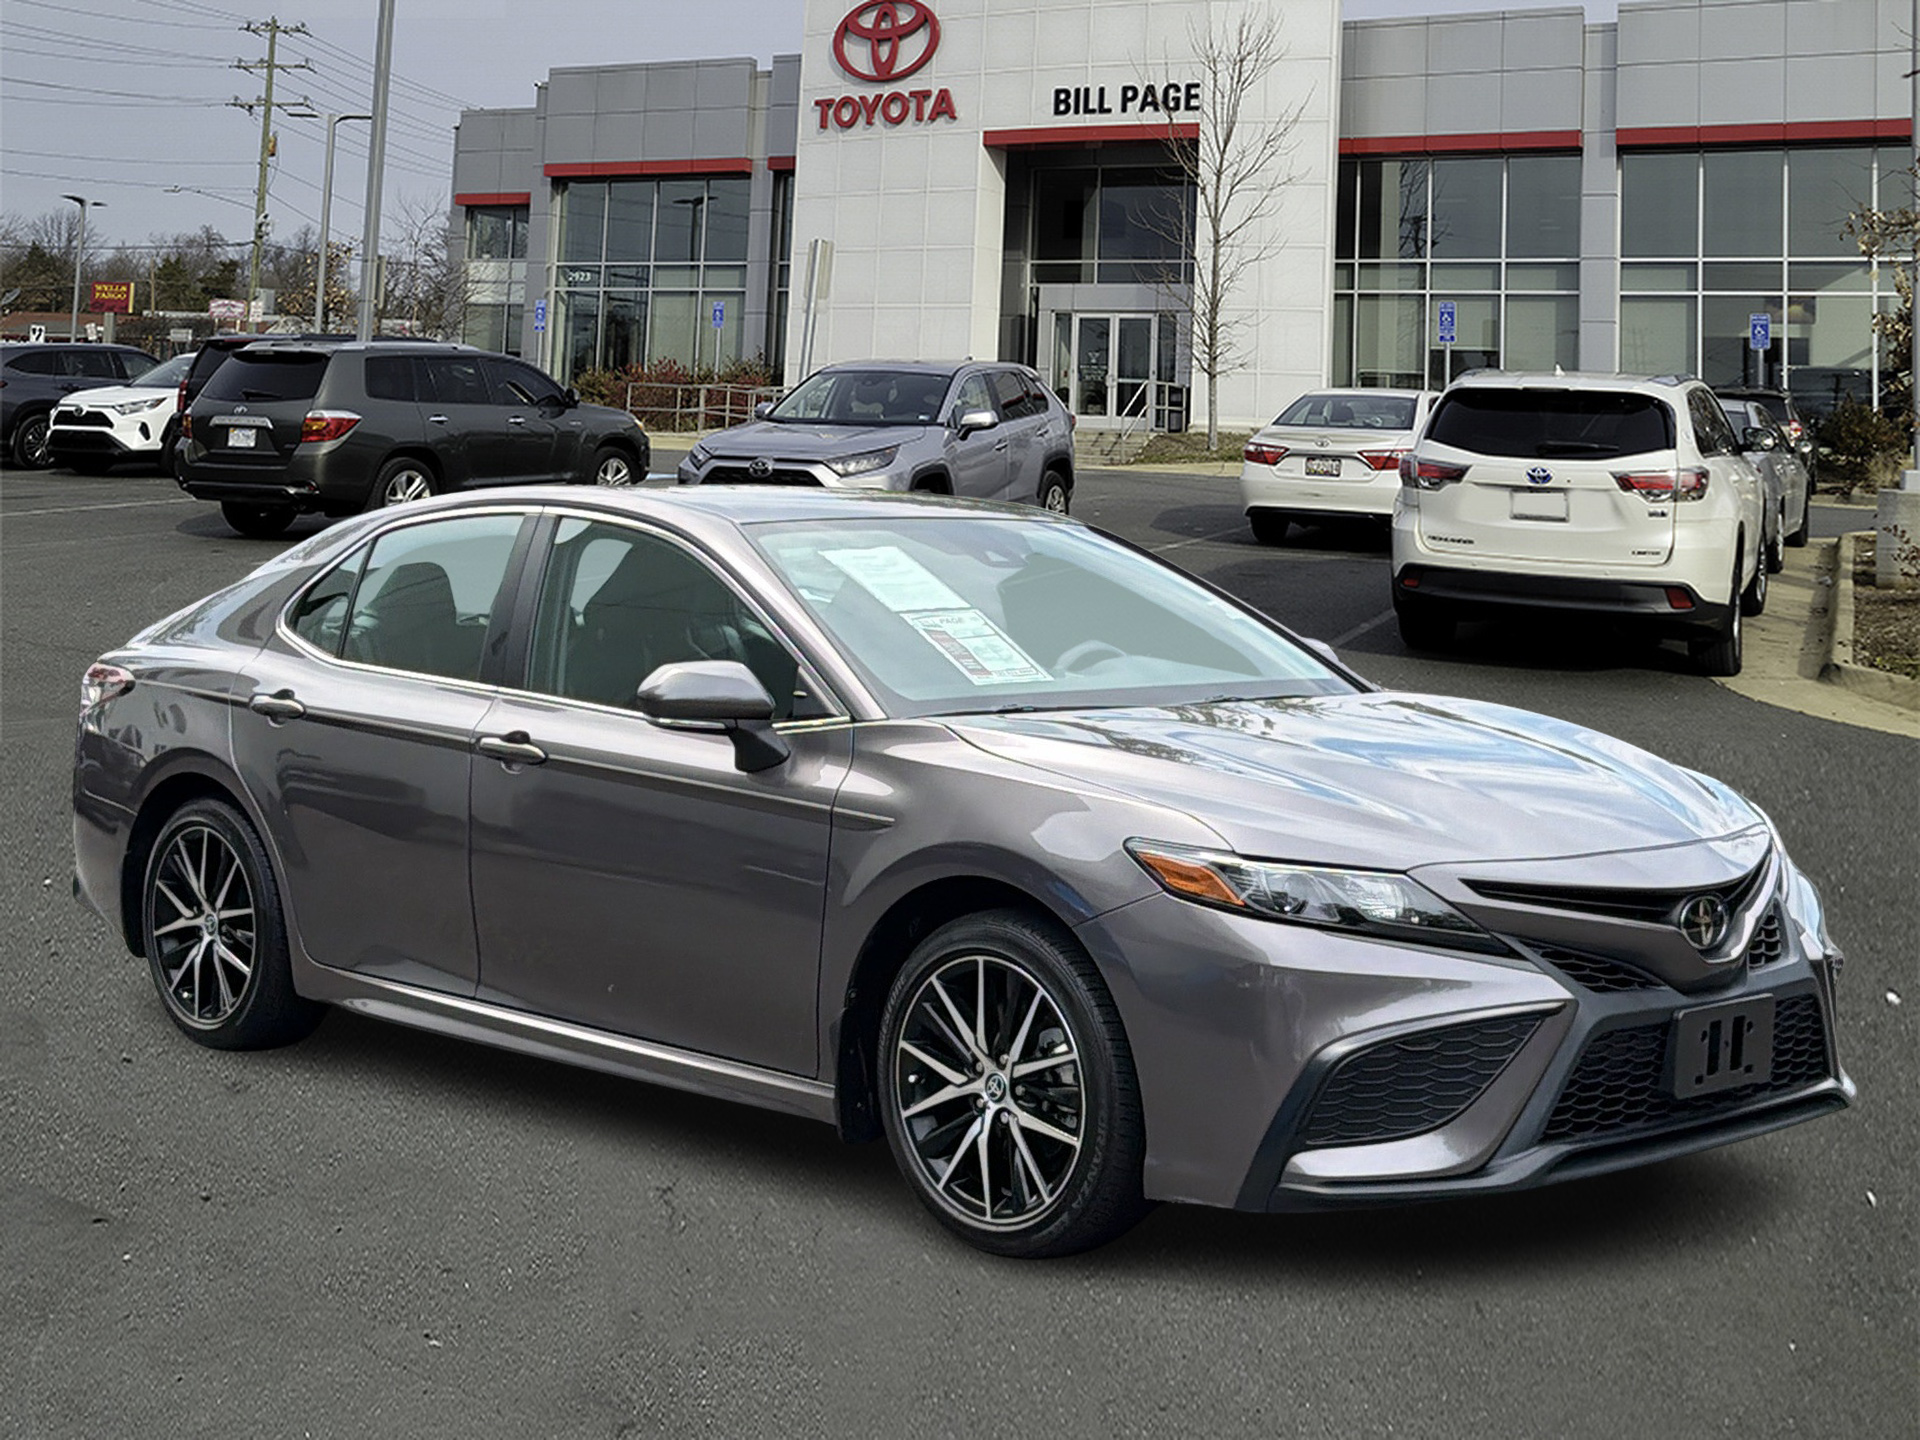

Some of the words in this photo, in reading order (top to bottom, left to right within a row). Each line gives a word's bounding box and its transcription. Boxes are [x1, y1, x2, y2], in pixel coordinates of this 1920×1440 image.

[814, 88, 958, 129] TOYOTA
[1053, 87, 1112, 115] BILL
[1121, 82, 1201, 113] PAGE
[95, 292, 127, 300] FARGO
